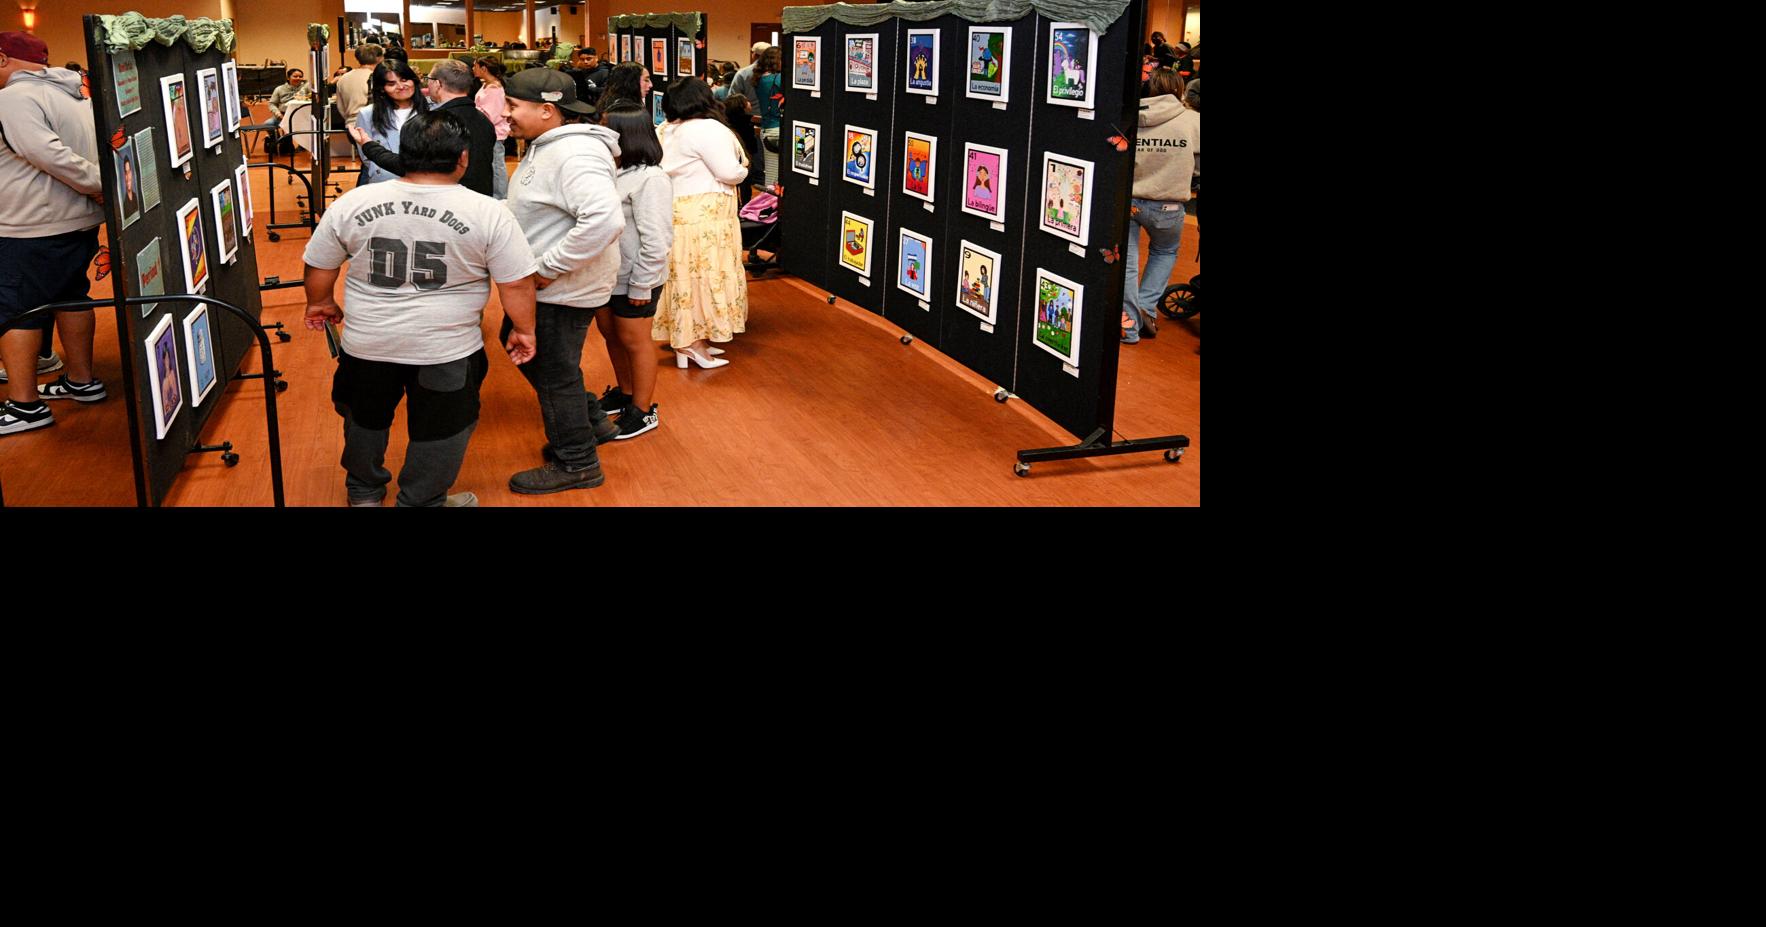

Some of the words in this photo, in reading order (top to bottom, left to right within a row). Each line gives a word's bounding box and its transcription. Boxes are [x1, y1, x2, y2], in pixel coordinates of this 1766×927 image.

[1055, 32, 1063, 41] 54
[354, 202, 396, 227] JUNK
[1047, 213, 1055, 225] La
[964, 250, 971, 259] 9
[367, 236, 447, 291] D5
